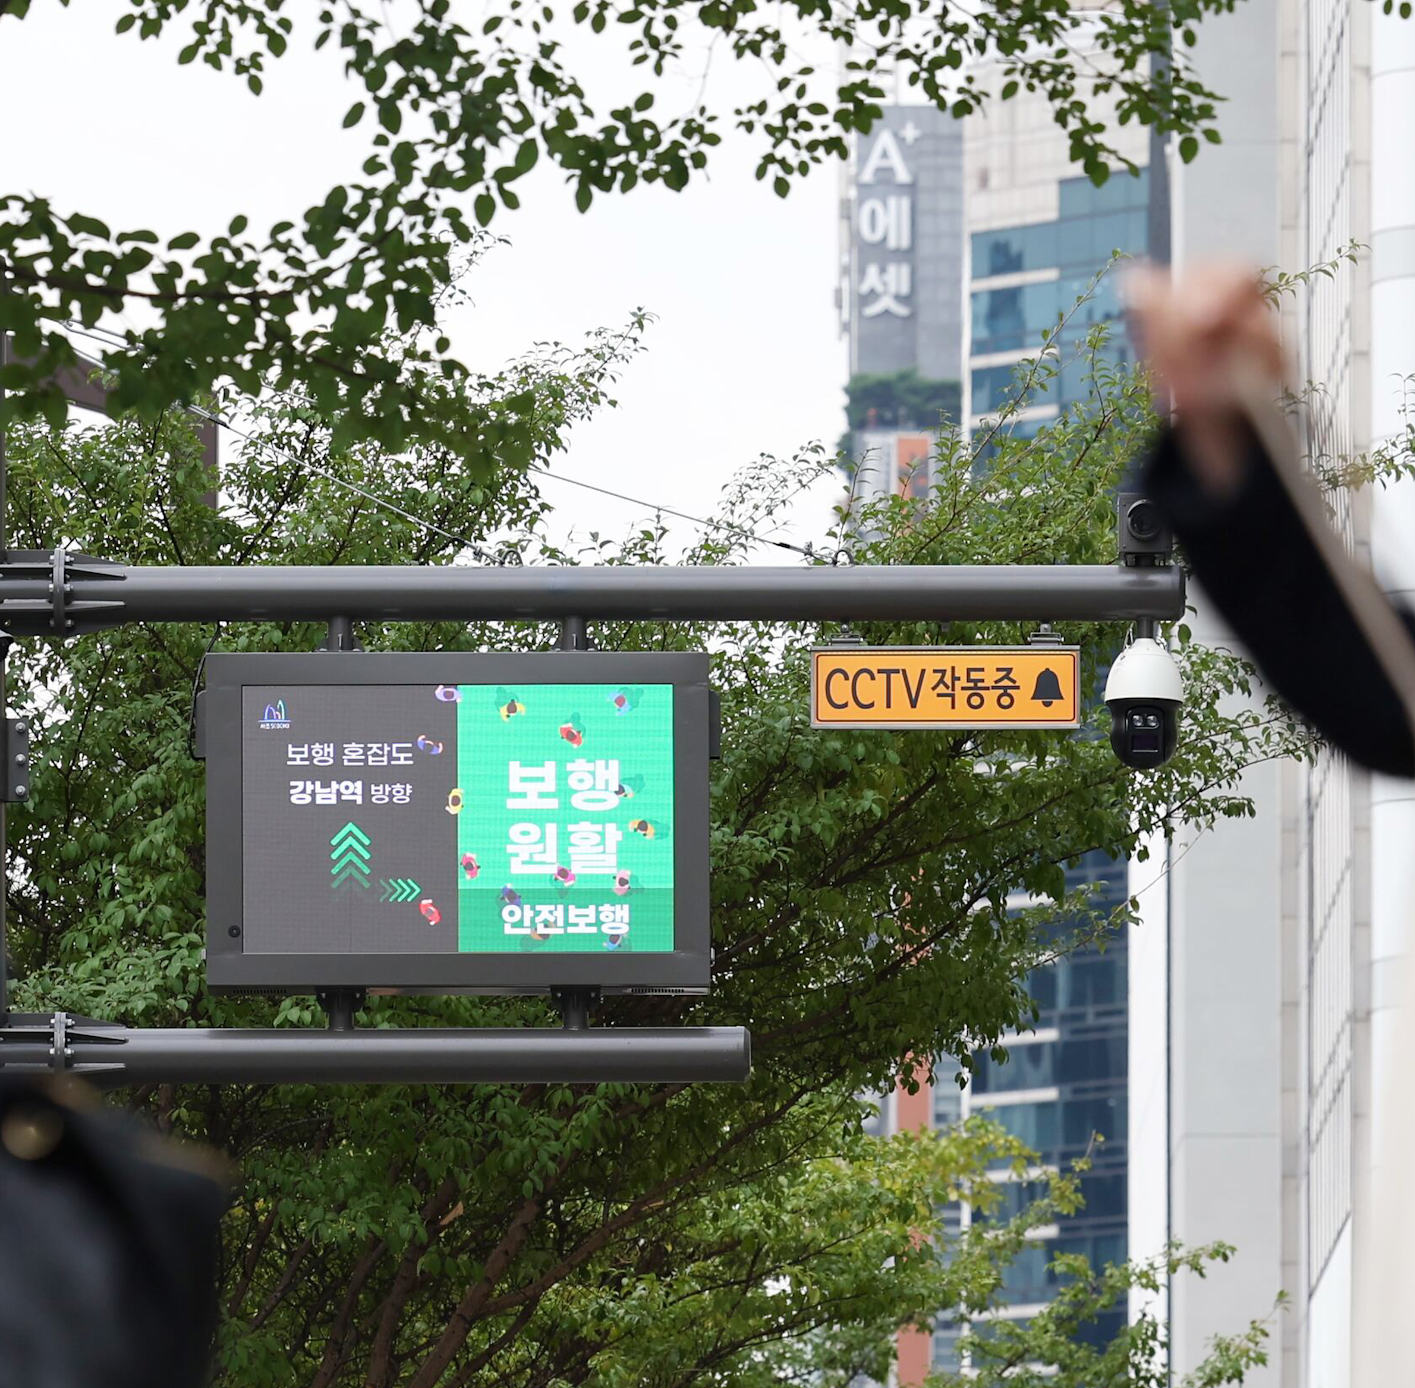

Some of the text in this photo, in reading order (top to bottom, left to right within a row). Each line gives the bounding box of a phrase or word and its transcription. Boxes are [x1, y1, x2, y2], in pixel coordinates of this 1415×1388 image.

[286, 742, 414, 766] 보행 혼잡도
[289, 780, 413, 805] 강남역 방향
[506, 758, 620, 812] 보행
[506, 821, 623, 874] 원활
[501, 903, 630, 935] 안전보행
